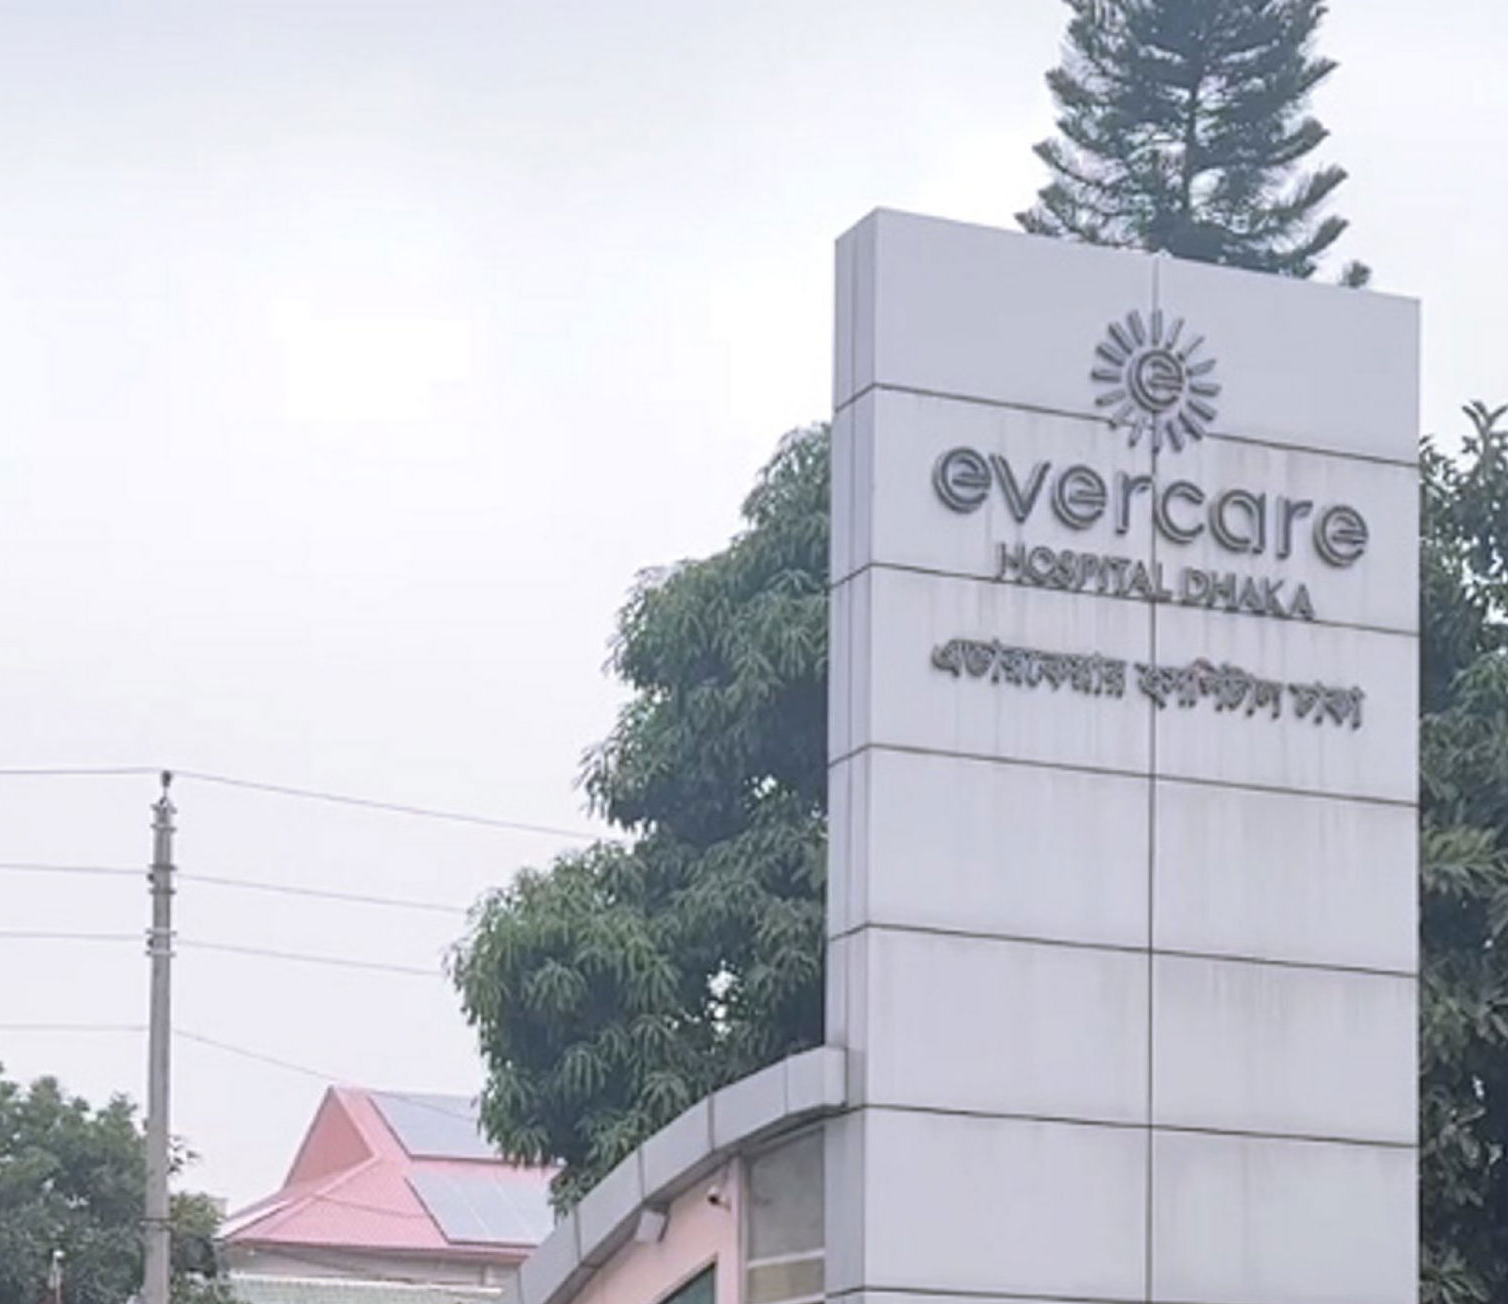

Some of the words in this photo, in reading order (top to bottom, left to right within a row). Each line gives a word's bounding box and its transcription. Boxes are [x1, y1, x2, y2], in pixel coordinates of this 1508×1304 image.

[932, 447, 1368, 567] evercare
[995, 543, 1171, 602] HOSPITAL
[1178, 567, 1314, 620] DHAKA
